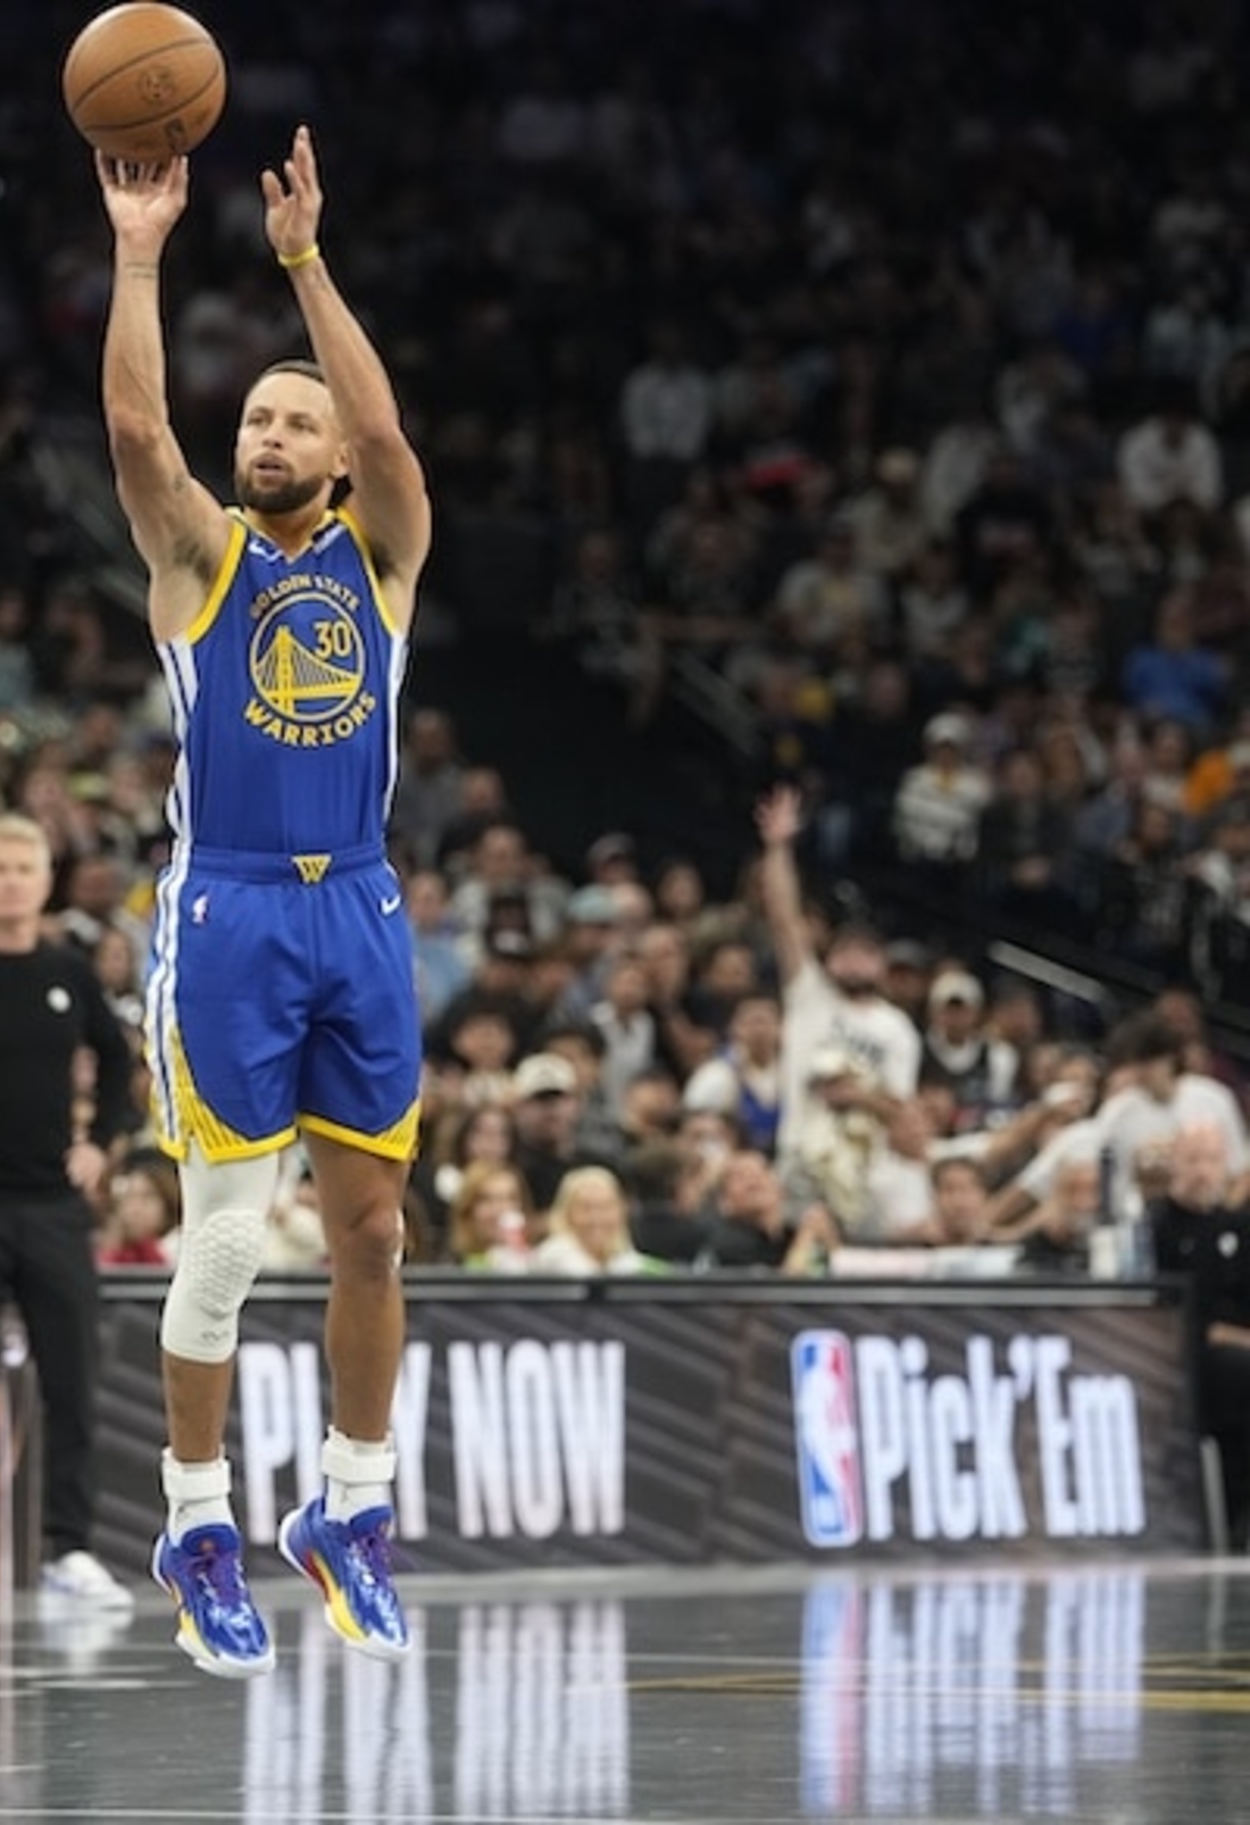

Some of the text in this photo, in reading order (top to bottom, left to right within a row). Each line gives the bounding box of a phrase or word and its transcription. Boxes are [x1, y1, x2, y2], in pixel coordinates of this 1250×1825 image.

[314, 574, 360, 612] STATE
[314, 621, 352, 659] 30
[244, 695, 376, 746] WARRIORS
[239, 1339, 625, 1544] PLY NOW
[854, 1334, 1145, 1541] Pick'Em
